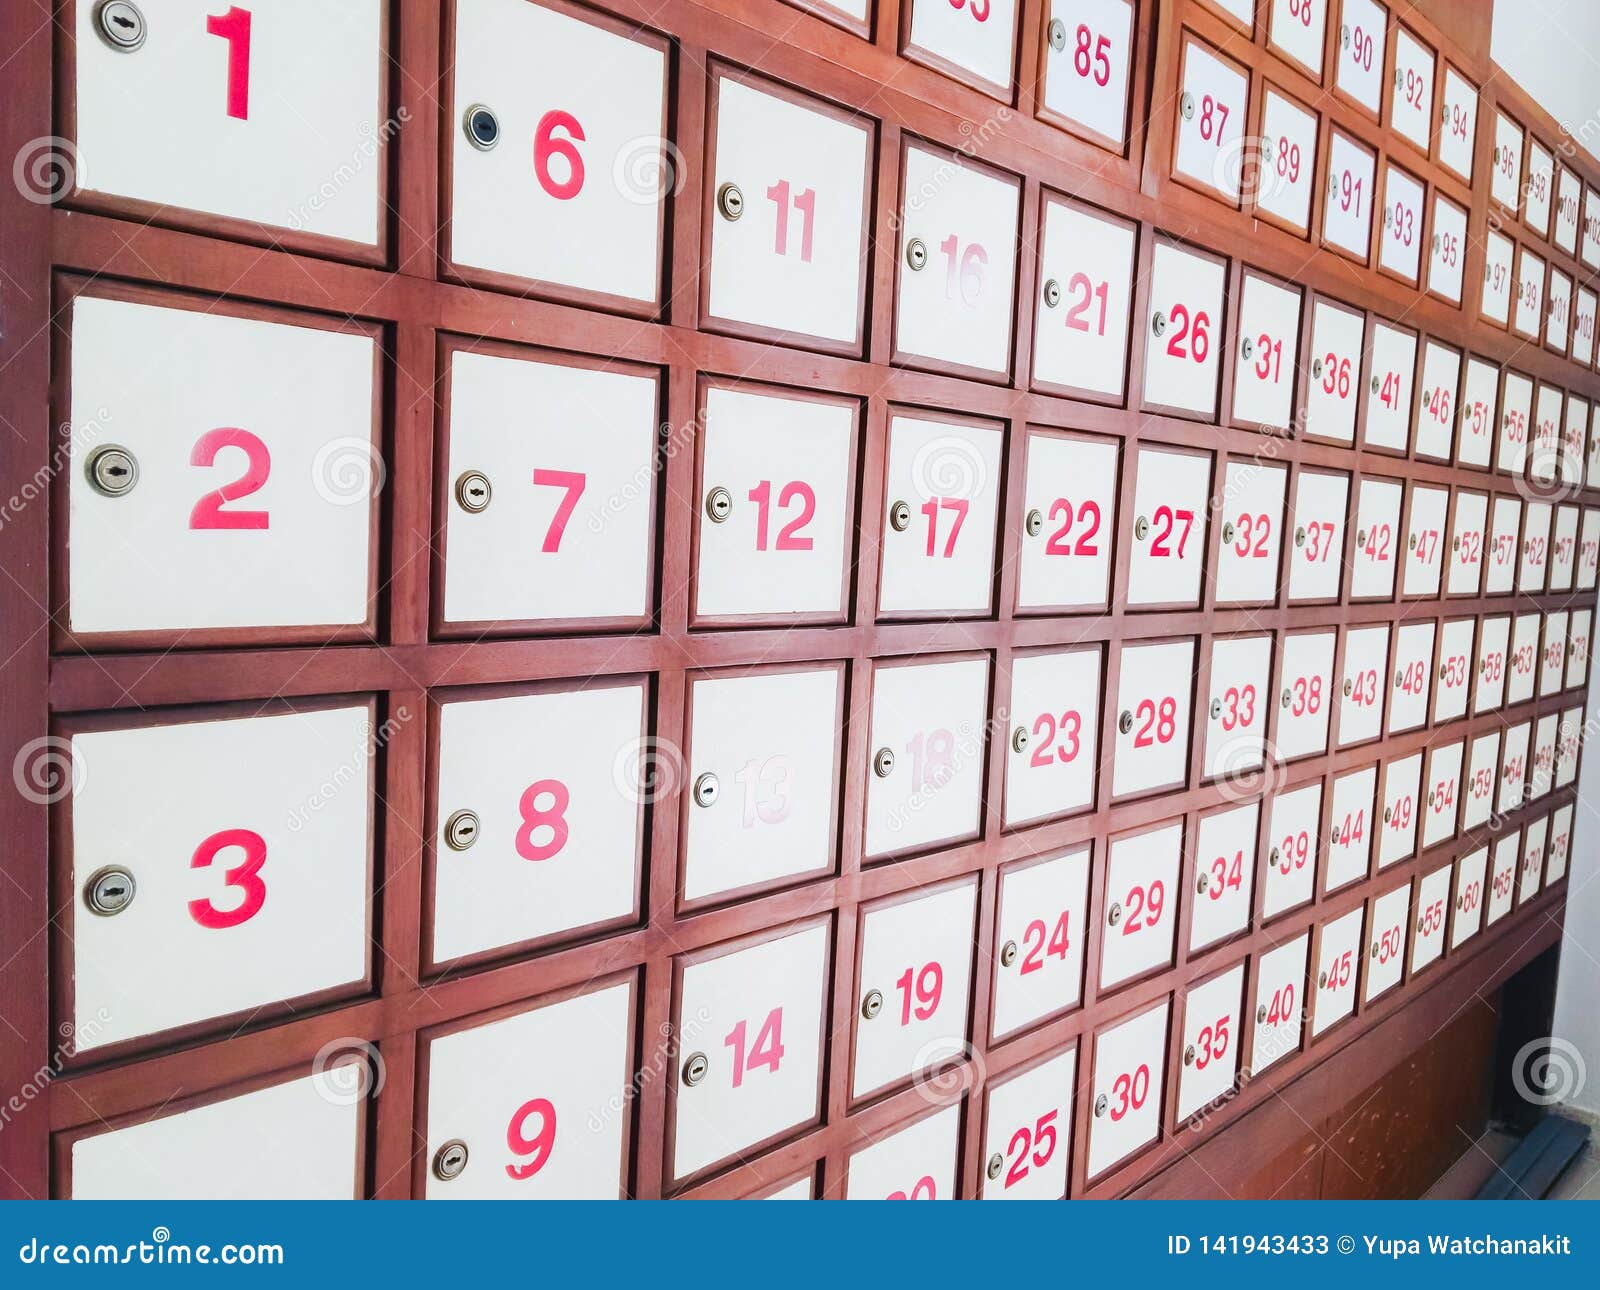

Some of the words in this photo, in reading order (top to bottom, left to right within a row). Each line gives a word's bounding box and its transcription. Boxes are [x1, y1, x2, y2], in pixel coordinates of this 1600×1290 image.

[206, 5, 251, 121] 1
[1074, 24, 1112, 86] 85
[1354, 26, 1372, 72] 90
[1407, 69, 1423, 111] 92
[1200, 95, 1229, 147] 87
[1453, 104, 1467, 142] 94
[534, 109, 586, 200] 6
[1277, 136, 1300, 183] 89
[1501, 145, 1514, 179] 96
[1341, 170, 1361, 218] 91
[1535, 173, 1545, 202] 98
[767, 179, 816, 263] 11
[1394, 202, 1413, 247] 93
[1442, 232, 1457, 268] 95
[941, 234, 989, 311] 16
[1494, 264, 1506, 293] 97
[1065, 272, 1109, 336] 21
[1525, 282, 1536, 310] 99
[1553, 297, 1566, 323] 101
[1167, 303, 1210, 363] 26
[1256, 334, 1282, 383] 31
[1323, 352, 1351, 399] 36
[1381, 372, 1400, 410] 41
[1429, 386, 1450, 424] 46
[1472, 401, 1488, 436] 51
[1509, 410, 1524, 443] 56
[1542, 420, 1554, 448] 61
[189, 427, 271, 529] 2
[533, 468, 586, 553] 7
[748, 480, 816, 552] 12
[921, 496, 969, 558] 17
[1045, 498, 1101, 555] 22
[1150, 505, 1194, 559] 27
[1235, 513, 1271, 558] 32
[1306, 521, 1335, 562] 37
[1365, 524, 1391, 561] 42
[1416, 530, 1439, 564] 47
[1461, 531, 1480, 564] 52
[1498, 535, 1513, 565] 57
[1529, 537, 1543, 565] 62
[1559, 538, 1573, 564] 67
[1402, 661, 1424, 695] 48
[1446, 655, 1466, 687] 53
[1518, 646, 1532, 673] 63
[1222, 684, 1256, 731] 33
[1293, 676, 1322, 717] 38
[1352, 670, 1377, 707] 43
[1030, 710, 1081, 767] 23
[1133, 696, 1177, 748] 28
[735, 755, 796, 828] 13
[1474, 768, 1491, 799] 59
[1508, 756, 1522, 785] 64
[1391, 796, 1411, 831] 49
[1435, 779, 1453, 813] 54
[515, 779, 569, 861] 8
[1340, 809, 1364, 848] 44
[1210, 850, 1242, 900] 34
[1280, 831, 1308, 875] 39
[188, 829, 267, 929] 3
[1464, 880, 1479, 913] 60
[1496, 867, 1512, 899] 65
[1122, 880, 1164, 936] 29
[1423, 900, 1443, 937] 55
[1020, 911, 1070, 976] 24
[1379, 926, 1399, 964] 50
[1327, 951, 1352, 991] 45
[896, 961, 943, 1026] 19
[1267, 984, 1294, 1028] 40
[724, 1007, 784, 1088] 14
[1196, 1015, 1230, 1070] 35
[1110, 1064, 1149, 1121] 30
[505, 1098, 556, 1180] 9
[1005, 1109, 1058, 1189] 25
